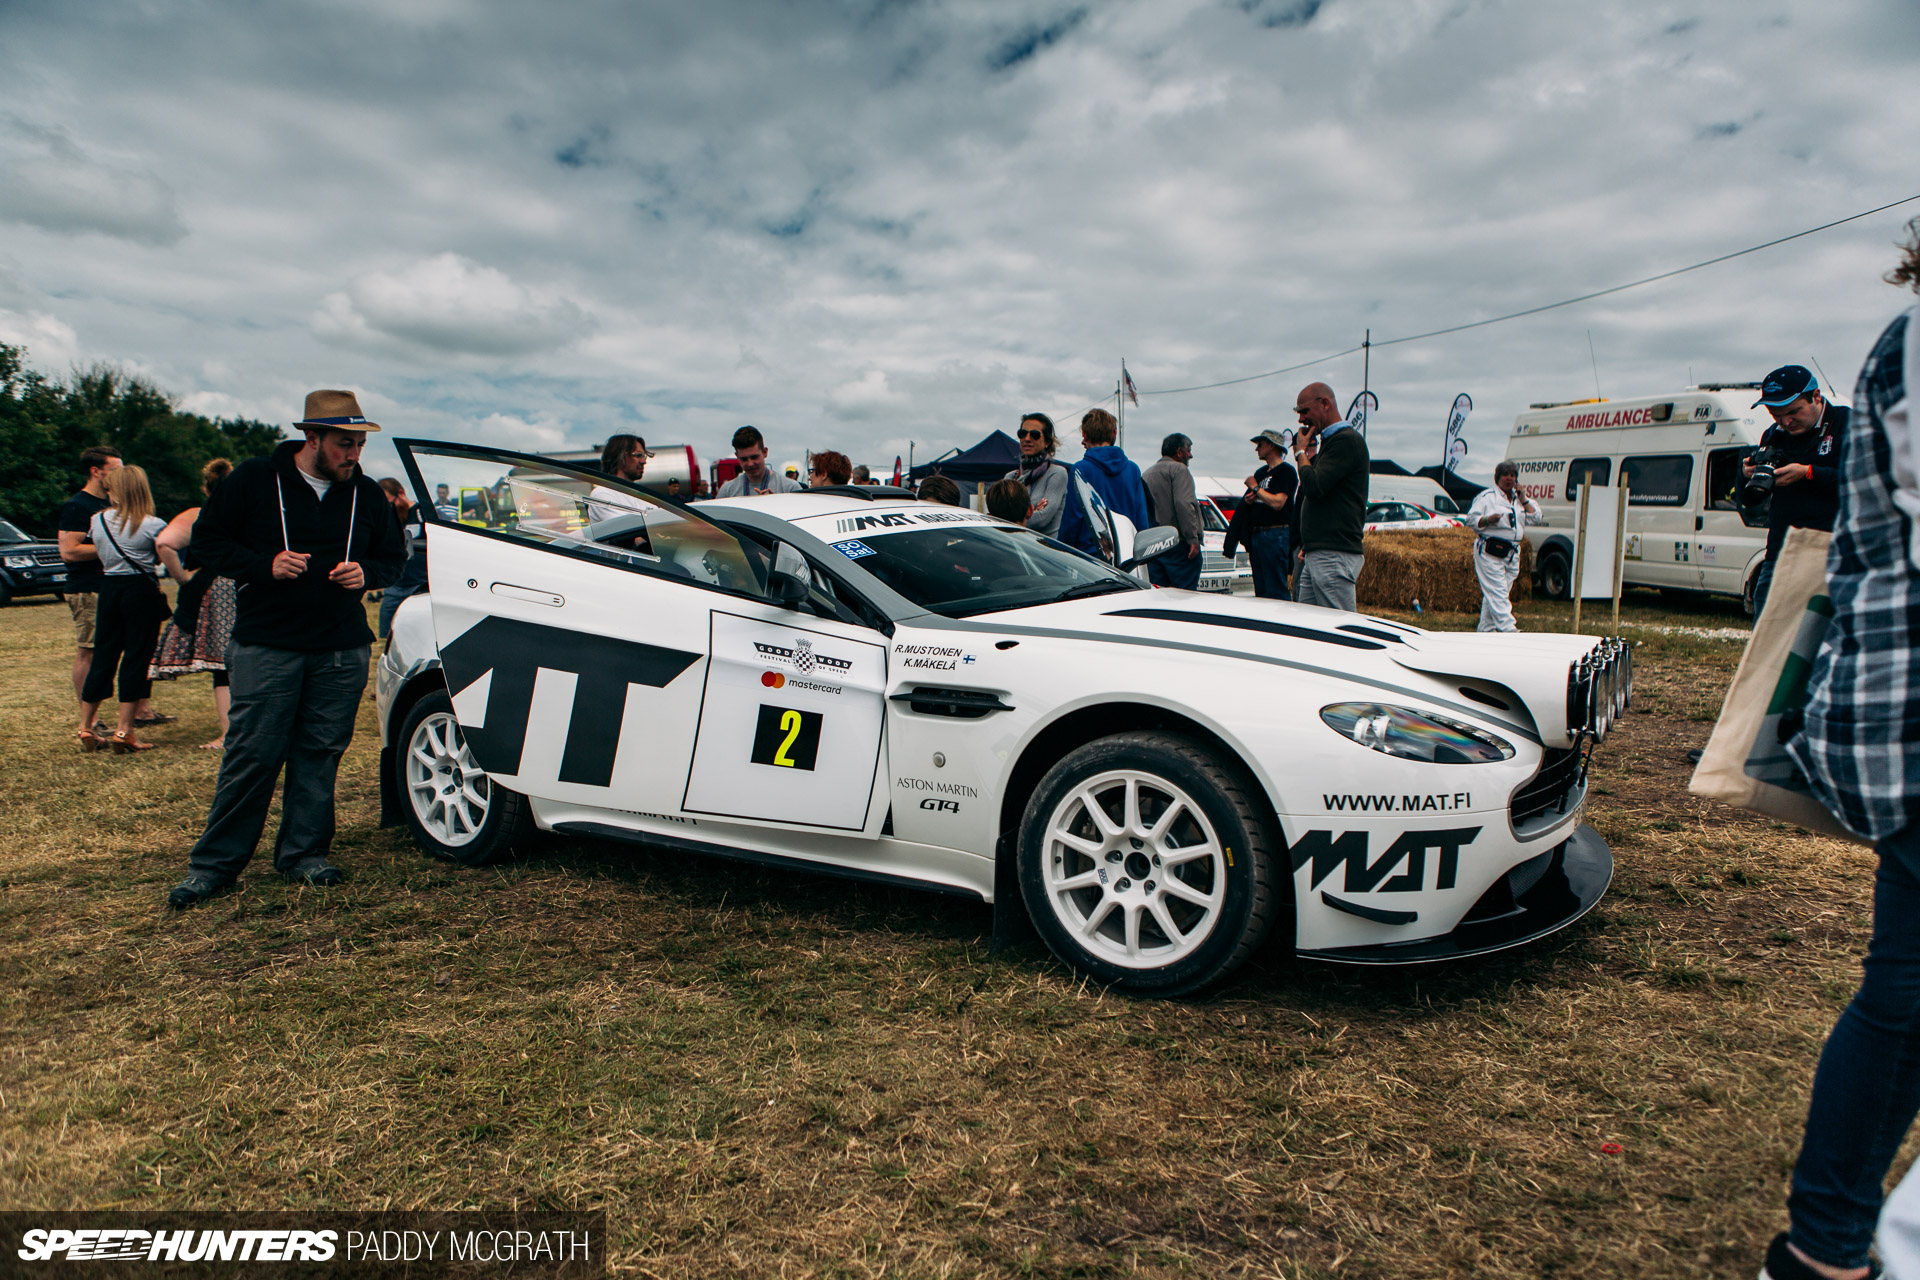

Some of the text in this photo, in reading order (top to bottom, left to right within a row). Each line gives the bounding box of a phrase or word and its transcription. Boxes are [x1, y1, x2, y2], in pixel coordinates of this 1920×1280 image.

[1566, 407, 1652, 430] AMBULANCE
[1694, 406, 1711, 418] FIA
[1522, 484, 1556, 499] SCUE
[854, 512, 918, 531] MAT
[1211, 579, 1220, 588] PL
[1222, 579, 1230, 587] 12
[758, 645, 791, 657] GOOD
[818, 656, 849, 668] WOOD
[760, 653, 791, 664] FESTIVAL
[894, 644, 963, 657] R.MUSTONEN
[903, 657, 958, 671] K.MÄKELÄ
[788, 679, 842, 695] mastercard
[773, 710, 802, 767] 2
[896, 777, 978, 799] ASTON MARTIN
[919, 798, 960, 814] GT4
[1322, 792, 1472, 812] WWW.MAT.FI
[1289, 825, 1484, 893] MAT
